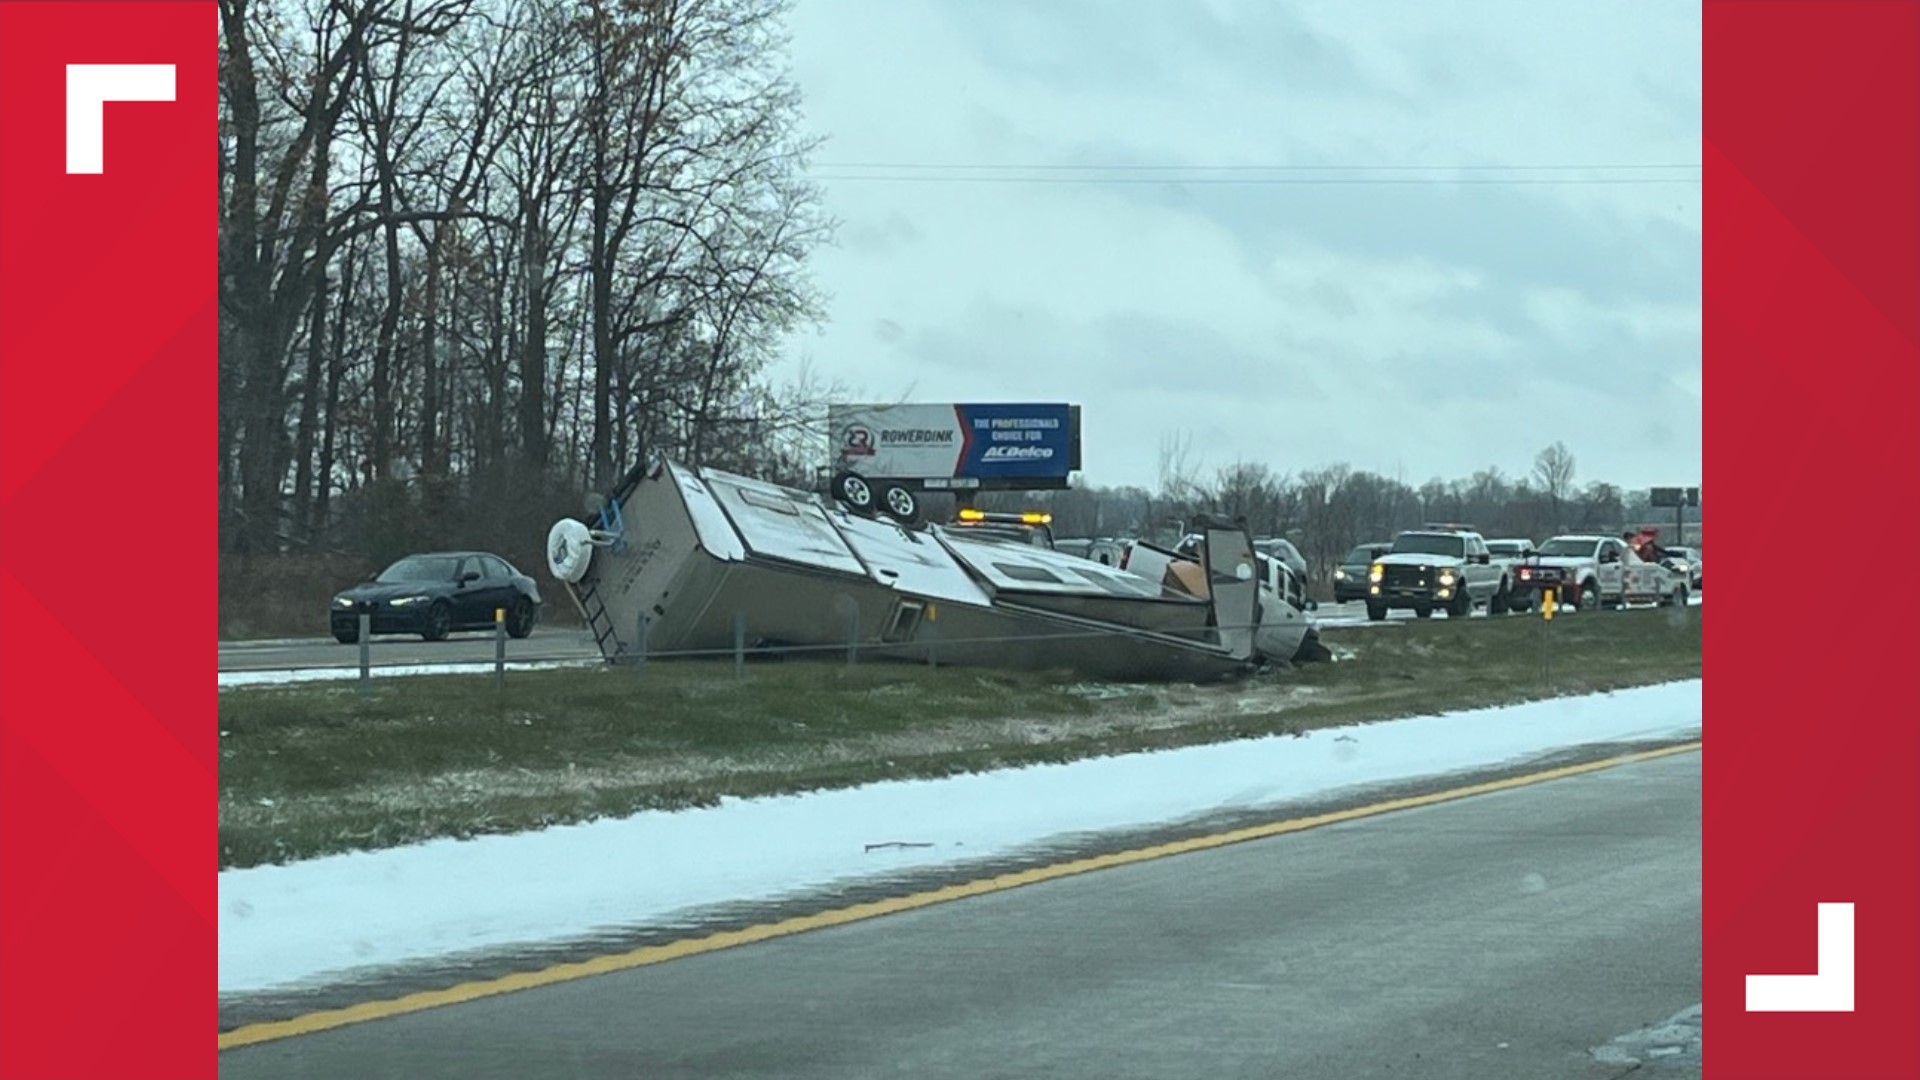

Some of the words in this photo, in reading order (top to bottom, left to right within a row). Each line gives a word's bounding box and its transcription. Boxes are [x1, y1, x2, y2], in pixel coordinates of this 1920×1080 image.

[974, 418, 989, 429] THE
[992, 418, 1059, 429] PROFESSIONALS
[880, 429, 954, 442] ROWERDINK
[992, 430, 1022, 441] CHOICE
[1025, 430, 1042, 441] FOR
[984, 445, 1054, 458] ACDelco
